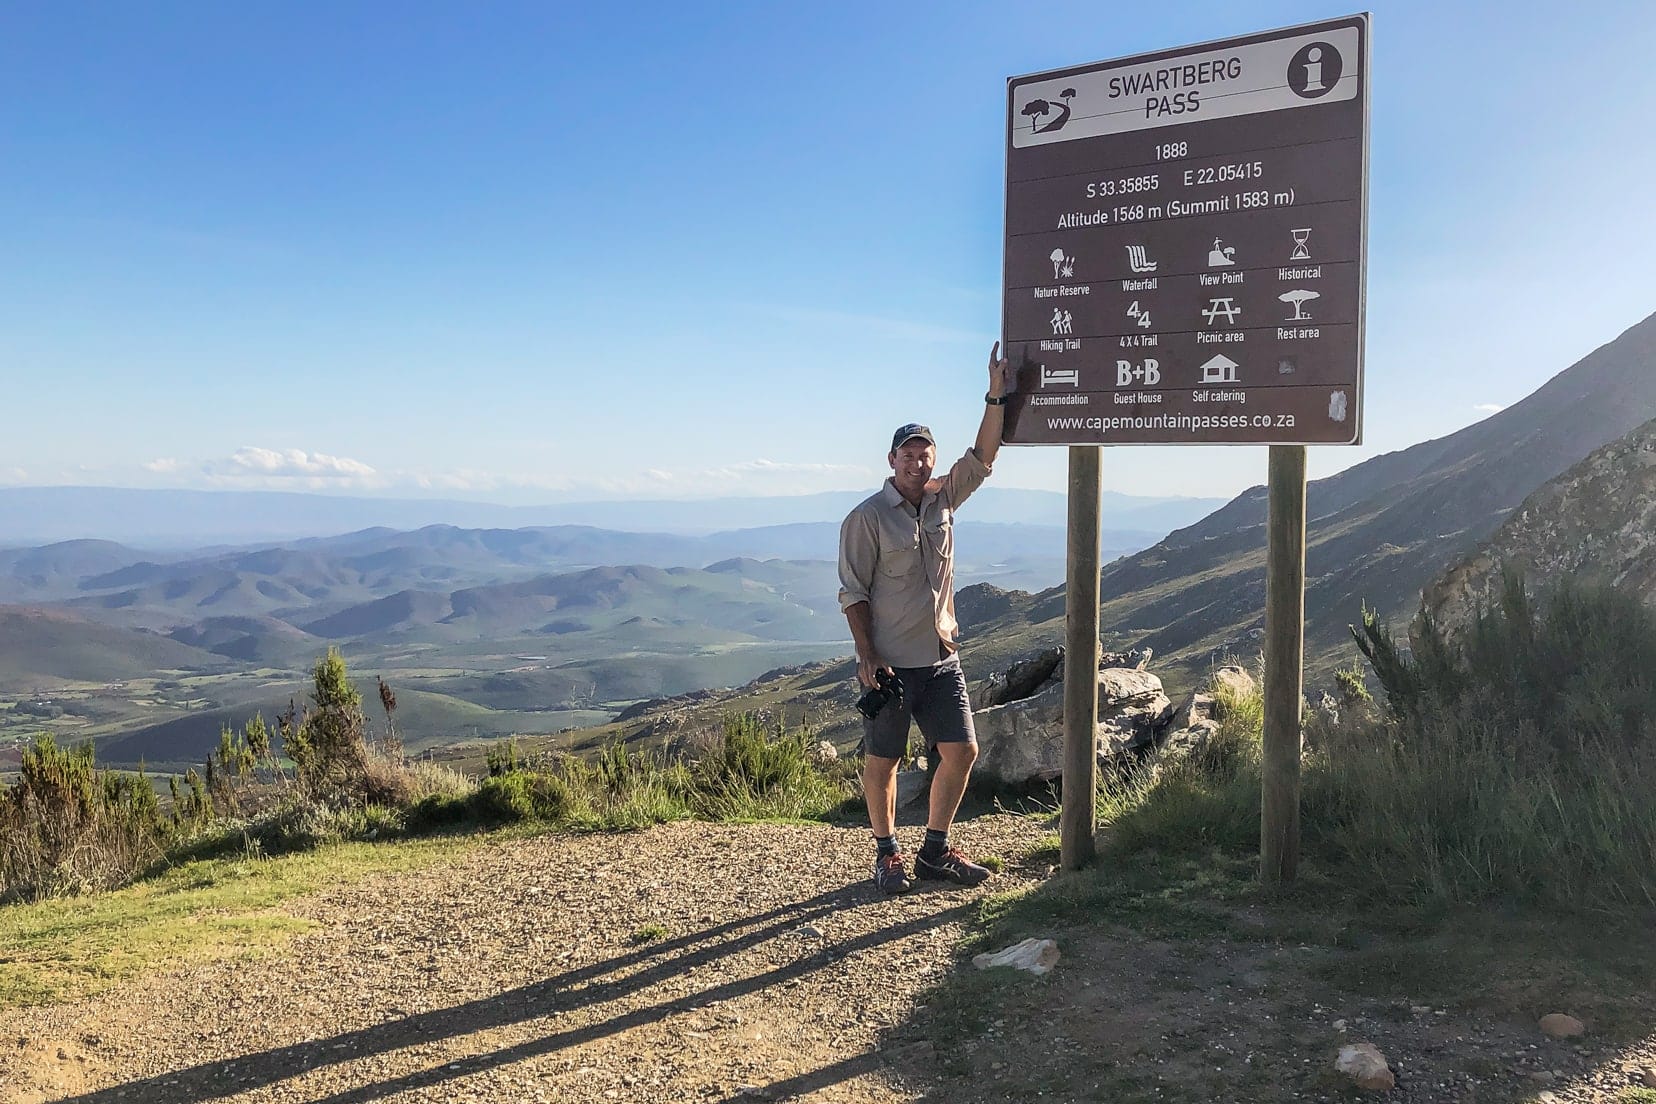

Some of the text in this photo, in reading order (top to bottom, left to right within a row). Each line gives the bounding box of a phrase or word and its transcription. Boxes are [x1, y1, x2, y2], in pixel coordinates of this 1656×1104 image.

[1108, 57, 1242, 99] SWARTBERG
[1146, 90, 1200, 118] PASS
[1155, 141, 1188, 160] 1888
[1086, 161, 1262, 198] S 33.35855 E 22.05415
[1057, 188, 1295, 228] Altitude 1568 m (Summit 1583 m)
[1200, 271, 1244, 286] View Point
[1278, 266, 1321, 280] Historical
[1034, 285, 1090, 298] Nature Reserve
[1122, 278, 1157, 291] Waterfall
[1140, 334, 1158, 346] Trail
[1197, 331, 1244, 343] Picnic area
[1277, 327, 1319, 340] Rest area
[1040, 338, 1081, 353] Hiking Trail
[1116, 358, 1160, 387] B+B
[1030, 393, 1089, 406] Accommodation
[1114, 392, 1162, 404] Guest House
[1192, 390, 1246, 403] Self catering
[1047, 412, 1295, 432] www.capemountainpasses.co.za
